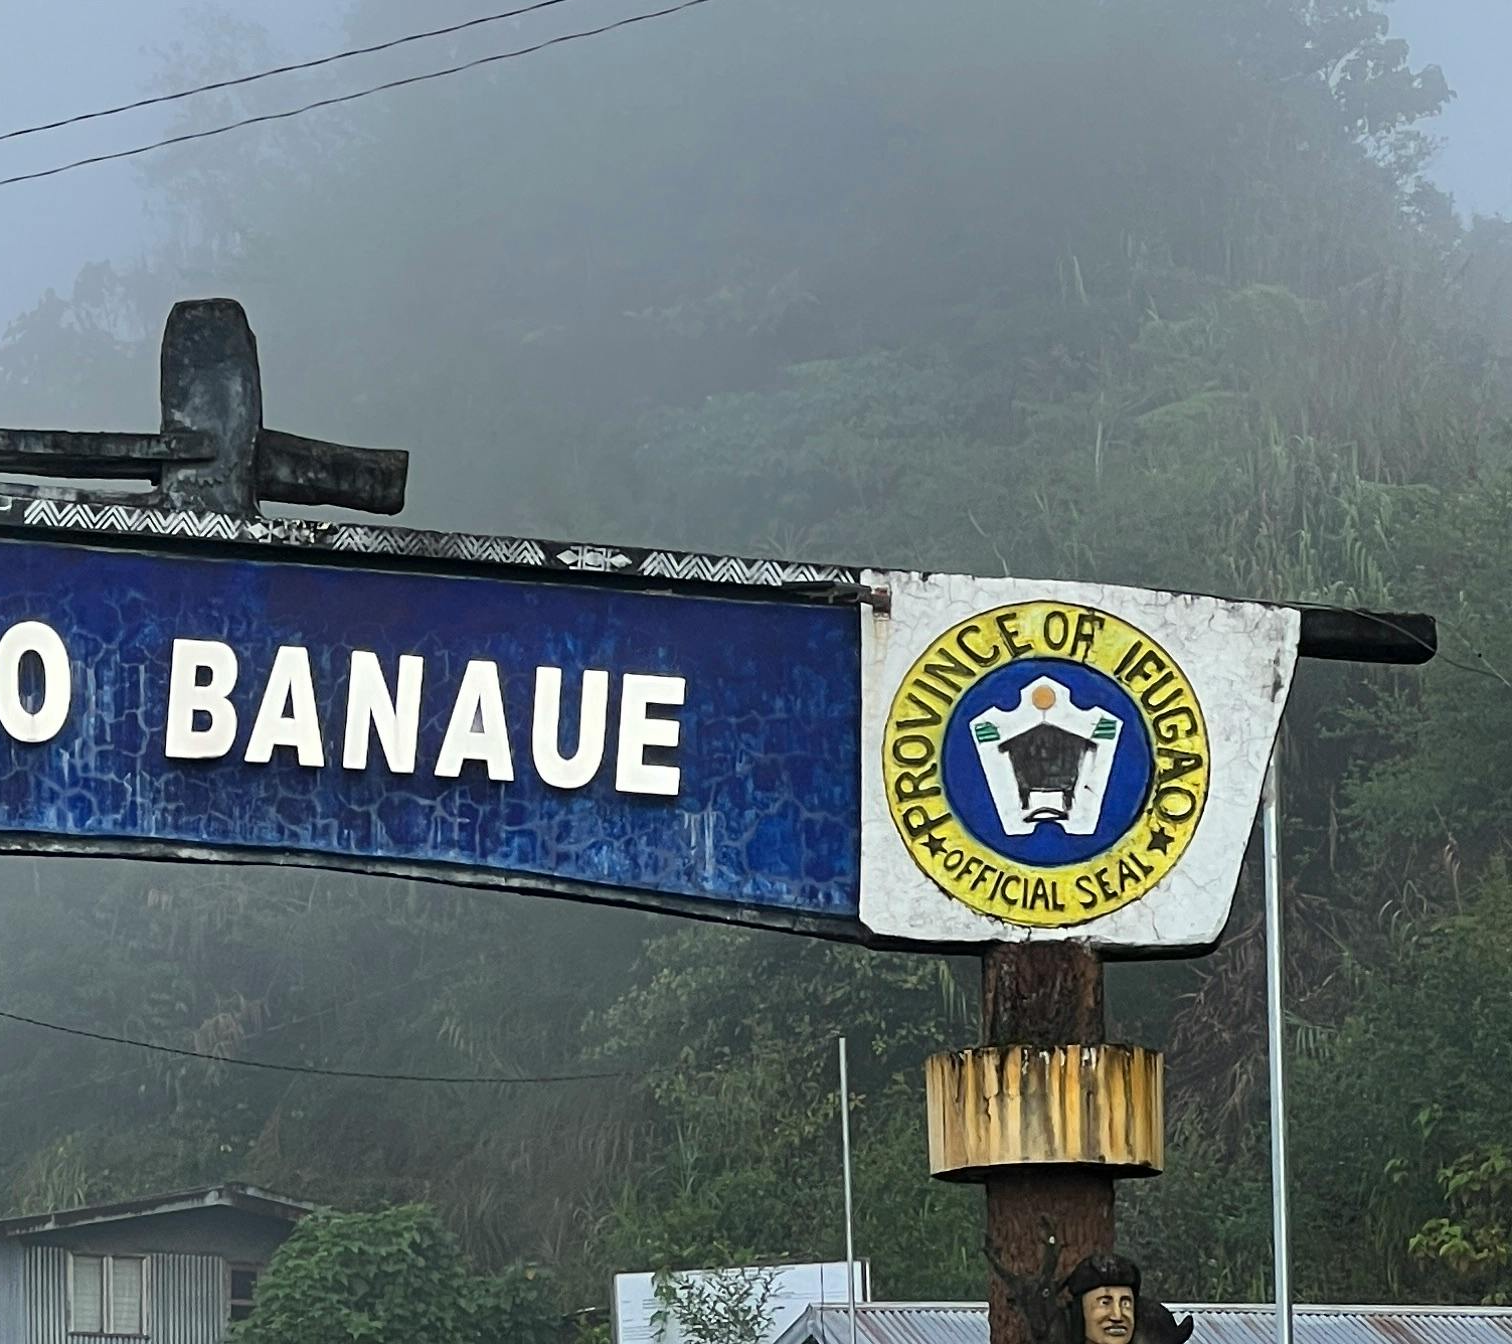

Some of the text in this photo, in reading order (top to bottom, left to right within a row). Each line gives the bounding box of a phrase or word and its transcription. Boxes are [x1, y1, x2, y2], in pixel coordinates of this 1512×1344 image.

[165, 638, 686, 797] BANAUE
[891, 610, 1203, 839] PROVINCE OF IFUGAO
[943, 850, 1154, 911] OFFICIAL SEAL
